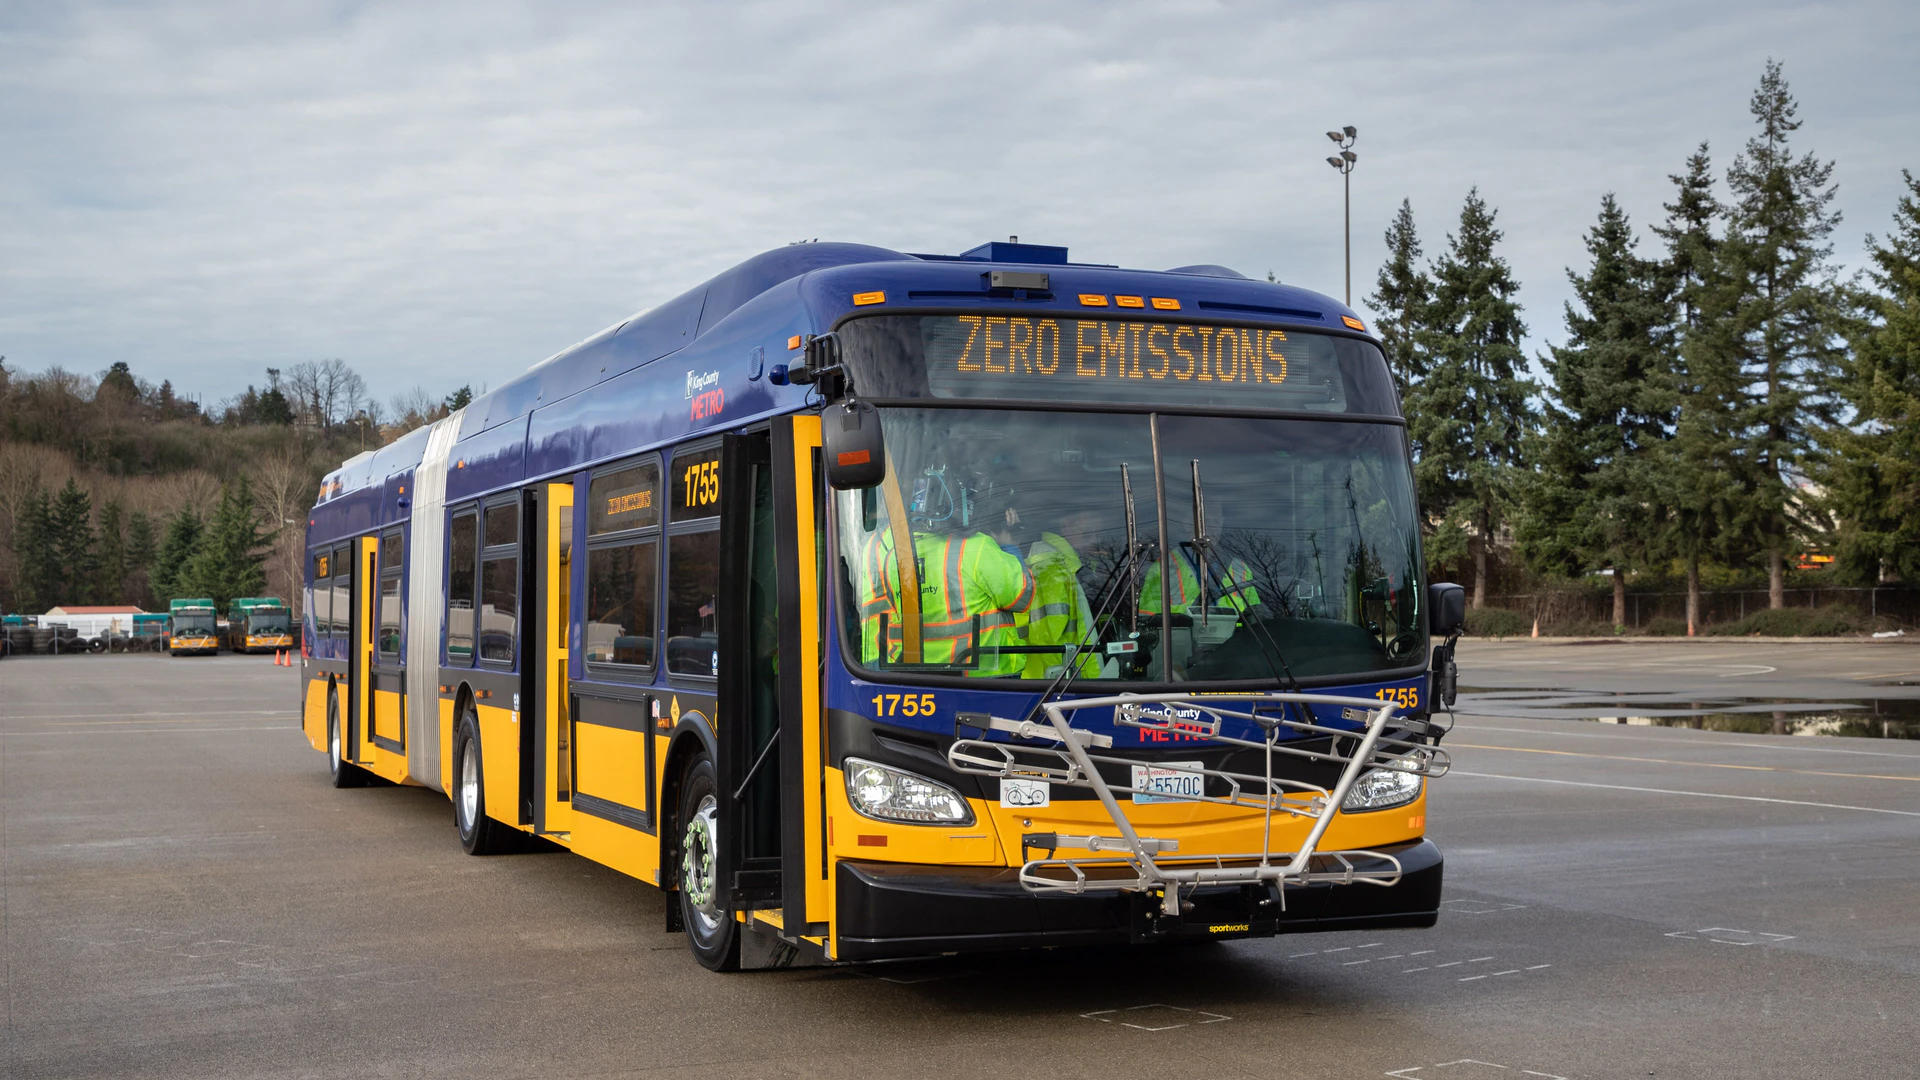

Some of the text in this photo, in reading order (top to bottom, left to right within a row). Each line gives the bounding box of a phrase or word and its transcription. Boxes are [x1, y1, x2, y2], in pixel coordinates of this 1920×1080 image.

[957, 315, 1287, 384] ZERO EMISSIONS
[693, 370, 719, 391] King County
[690, 387, 724, 421] METRO
[684, 461, 719, 507] 1755
[871, 693, 936, 717] 1755
[1375, 687, 1418, 709] 1755
[1164, 707, 1201, 720] County
[1140, 723, 1213, 742] METRO
[1138, 768, 1177, 776] WAHINGTON
[1209, 923, 1249, 933] sportworks
